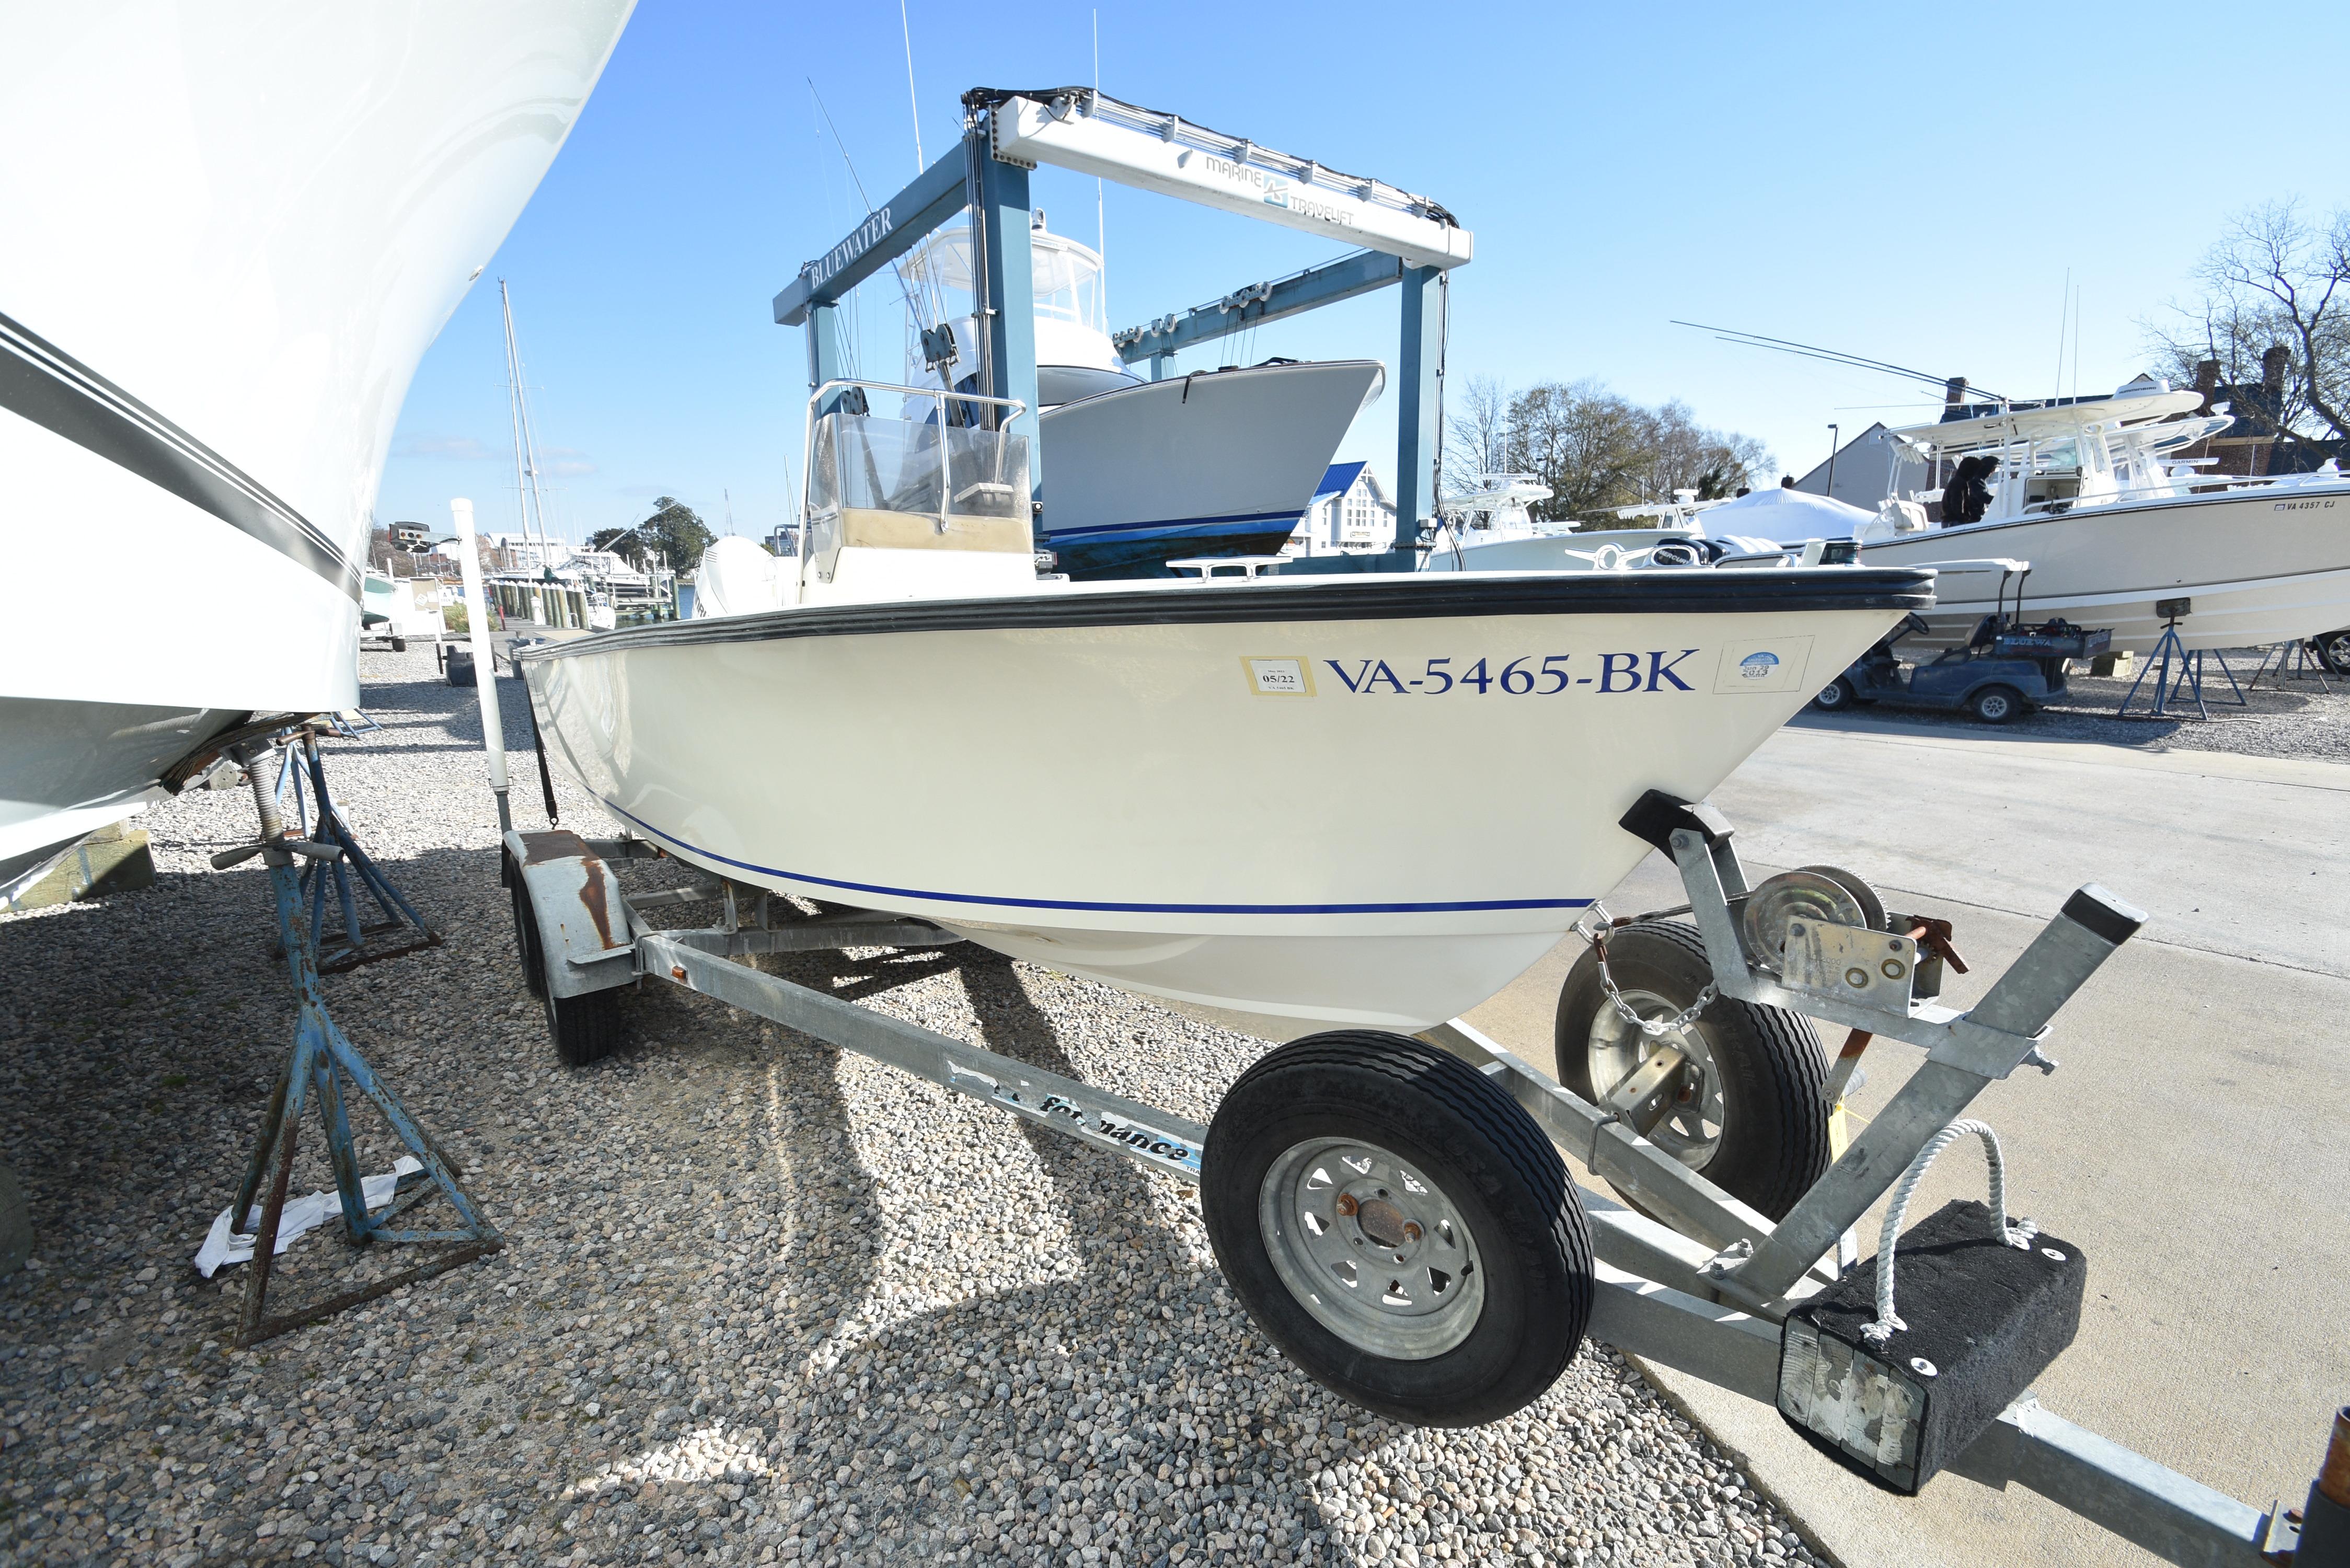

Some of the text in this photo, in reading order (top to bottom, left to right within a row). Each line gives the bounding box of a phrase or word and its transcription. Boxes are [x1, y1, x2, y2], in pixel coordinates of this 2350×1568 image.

[1206, 156, 1355, 226] MARINE TRAVELIFT
[811, 207, 893, 290] BLUEWATER
[2003, 637, 2055, 647] BLUEWA
[1262, 675, 1295, 683] 05/22
[1323, 648, 1700, 695] VA-5465-BK
[1186, 1166, 1201, 1175] TRA
